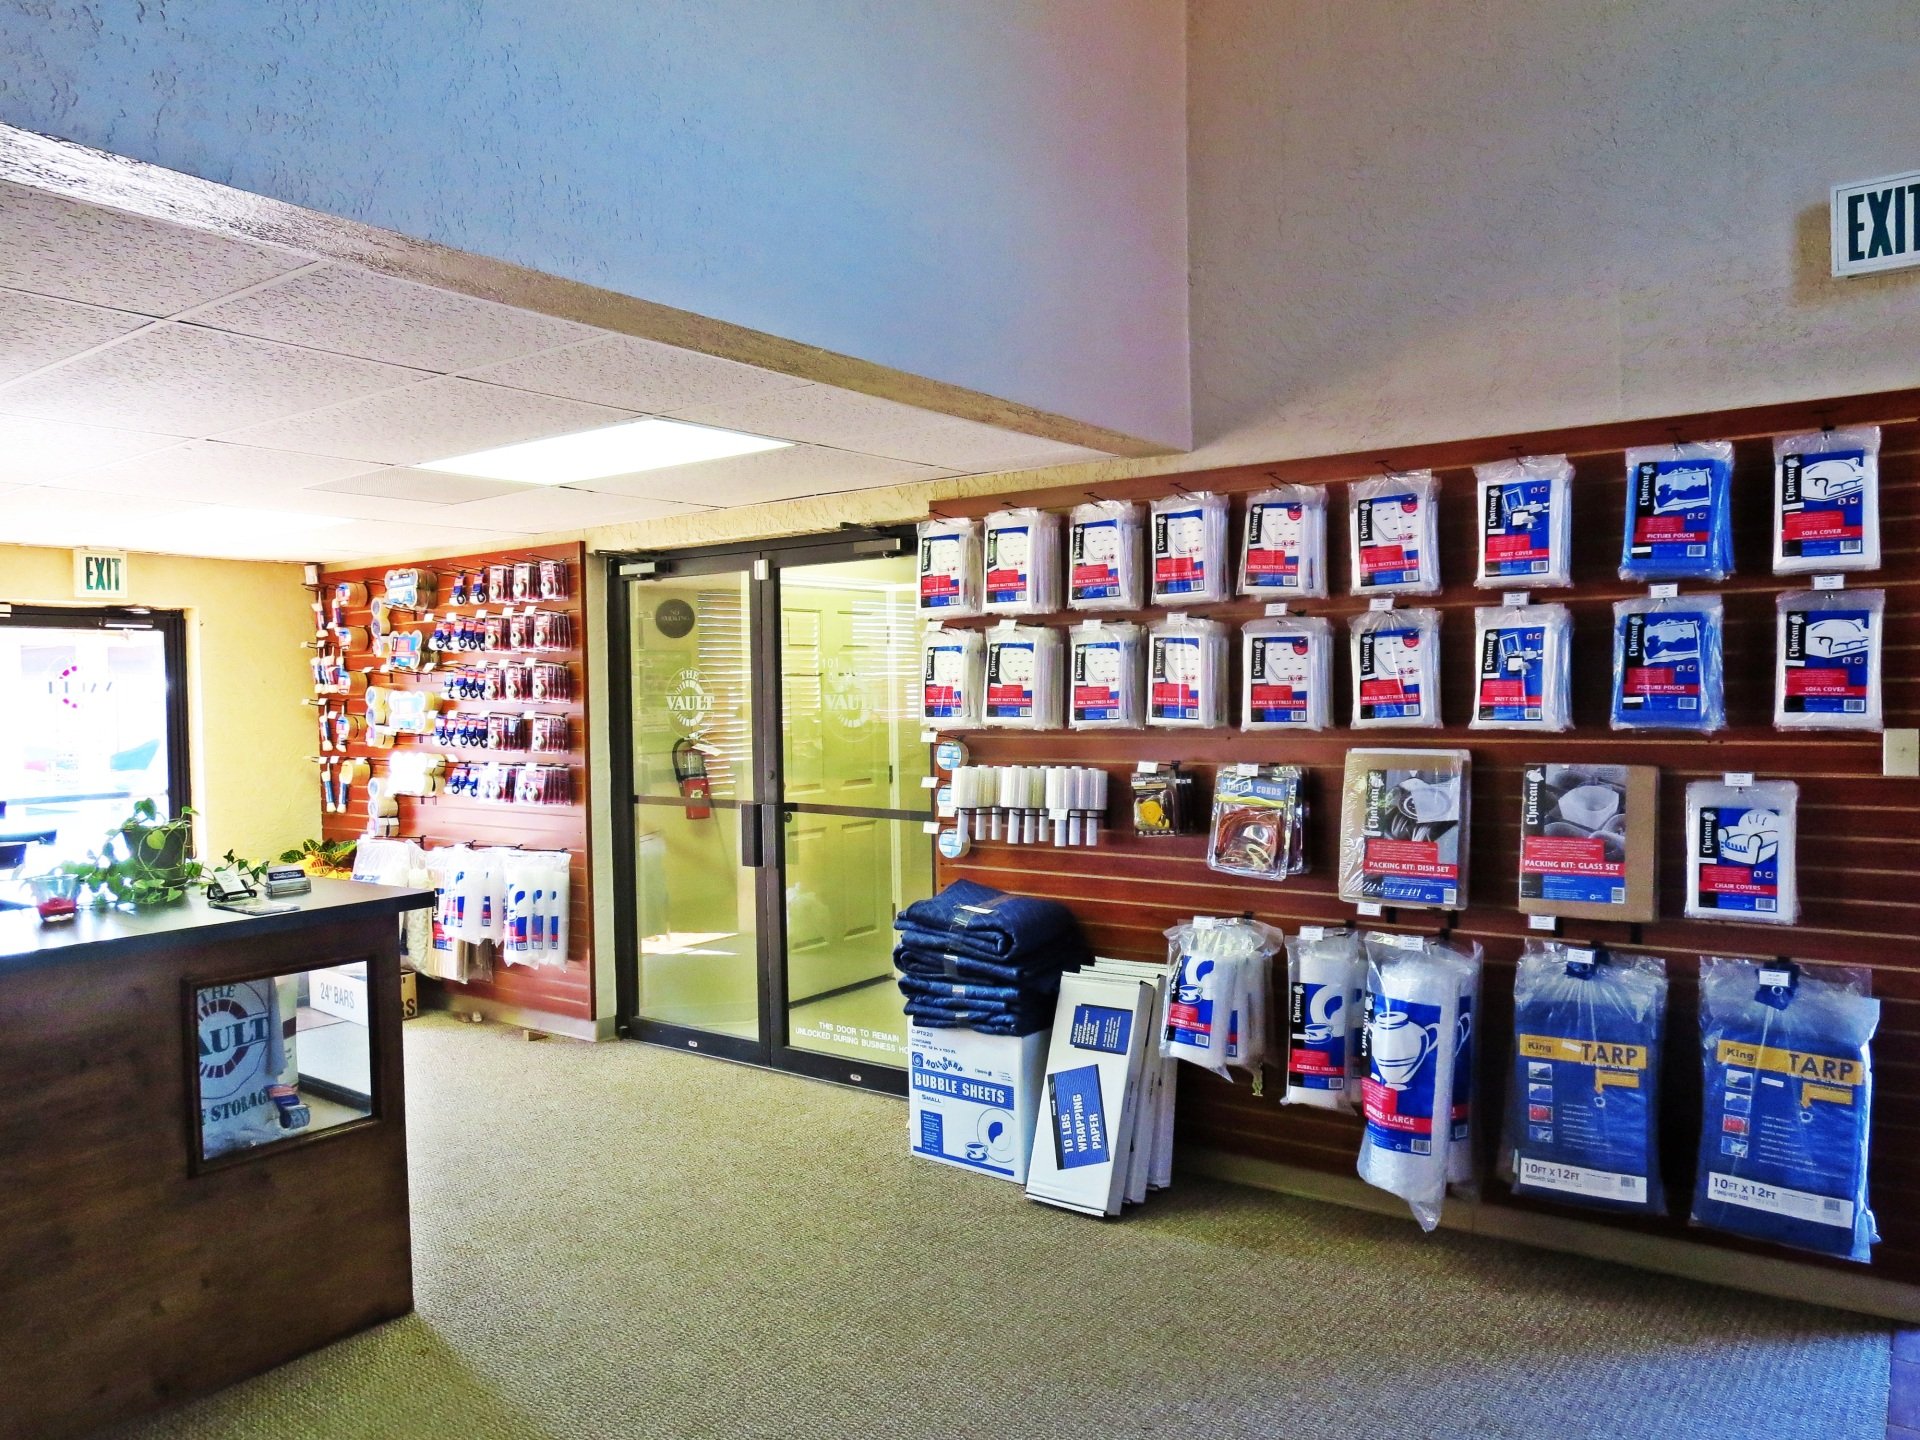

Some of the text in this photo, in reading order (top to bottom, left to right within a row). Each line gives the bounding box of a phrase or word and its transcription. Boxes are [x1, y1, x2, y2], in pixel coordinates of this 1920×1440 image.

[1848, 184, 1920, 261] EXIT
[1640, 475, 1650, 506] Chateau
[1786, 468, 1796, 501] Chateau
[1360, 510, 1368, 539] Chateau
[1488, 497, 1497, 527] Chateau
[1250, 513, 1258, 541] Chateau
[86, 557, 121, 591] EXIT
[1628, 625, 1639, 657] Chateau
[1789, 624, 1799, 657] Chateau
[1253, 648, 1261, 676] Chateau
[1362, 643, 1370, 672] Chateau
[1484, 640, 1494, 671] Chateau
[679, 670, 699, 680] THE
[666, 695, 715, 711] VAULT
[1256, 785, 1282, 796] CORDS
[1527, 782, 1538, 825] Chateau
[1368, 787, 1380, 828] Chateau
[1703, 821, 1713, 854] Chateau
[1369, 861, 1400, 870] PACKING
[1418, 864, 1435, 872] DISH
[1437, 865, 1450, 873] SET
[1525, 859, 1620, 871] PACKING KIT: GLASS SET
[1714, 882, 1761, 891] CHAIR COVERS
[199, 984, 236, 1004] THE
[334, 986, 355, 1009] BARS
[1293, 994, 1302, 1023] Chateau
[795, 1026, 831, 1040] UNLOCKED
[833, 1034, 859, 1046] DURING
[862, 1038, 896, 1052] BUSINESS
[819, 1022, 900, 1043] THIS DOOR TO REMAIN
[926, 1059, 942, 1069] ROLL
[1581, 1043, 1638, 1065] TARP
[1726, 1047, 1754, 1061] King
[1789, 1053, 1854, 1080] TARP
[914, 1072, 1005, 1104] BUBBLE SHEETS
[921, 1094, 942, 1104] SMALL
[1061, 1109, 1074, 1154] 10 LBS.
[1072, 1093, 1088, 1153] WRAPPING
[1089, 1113, 1102, 1150] PAPER
[1387, 1113, 1415, 1125] LARGE
[1524, 1162, 1546, 1174] 10FT
[1558, 1168, 1580, 1181] 12FT
[1713, 1177, 1738, 1190] 10FT
[1751, 1185, 1776, 1200] 12FT
